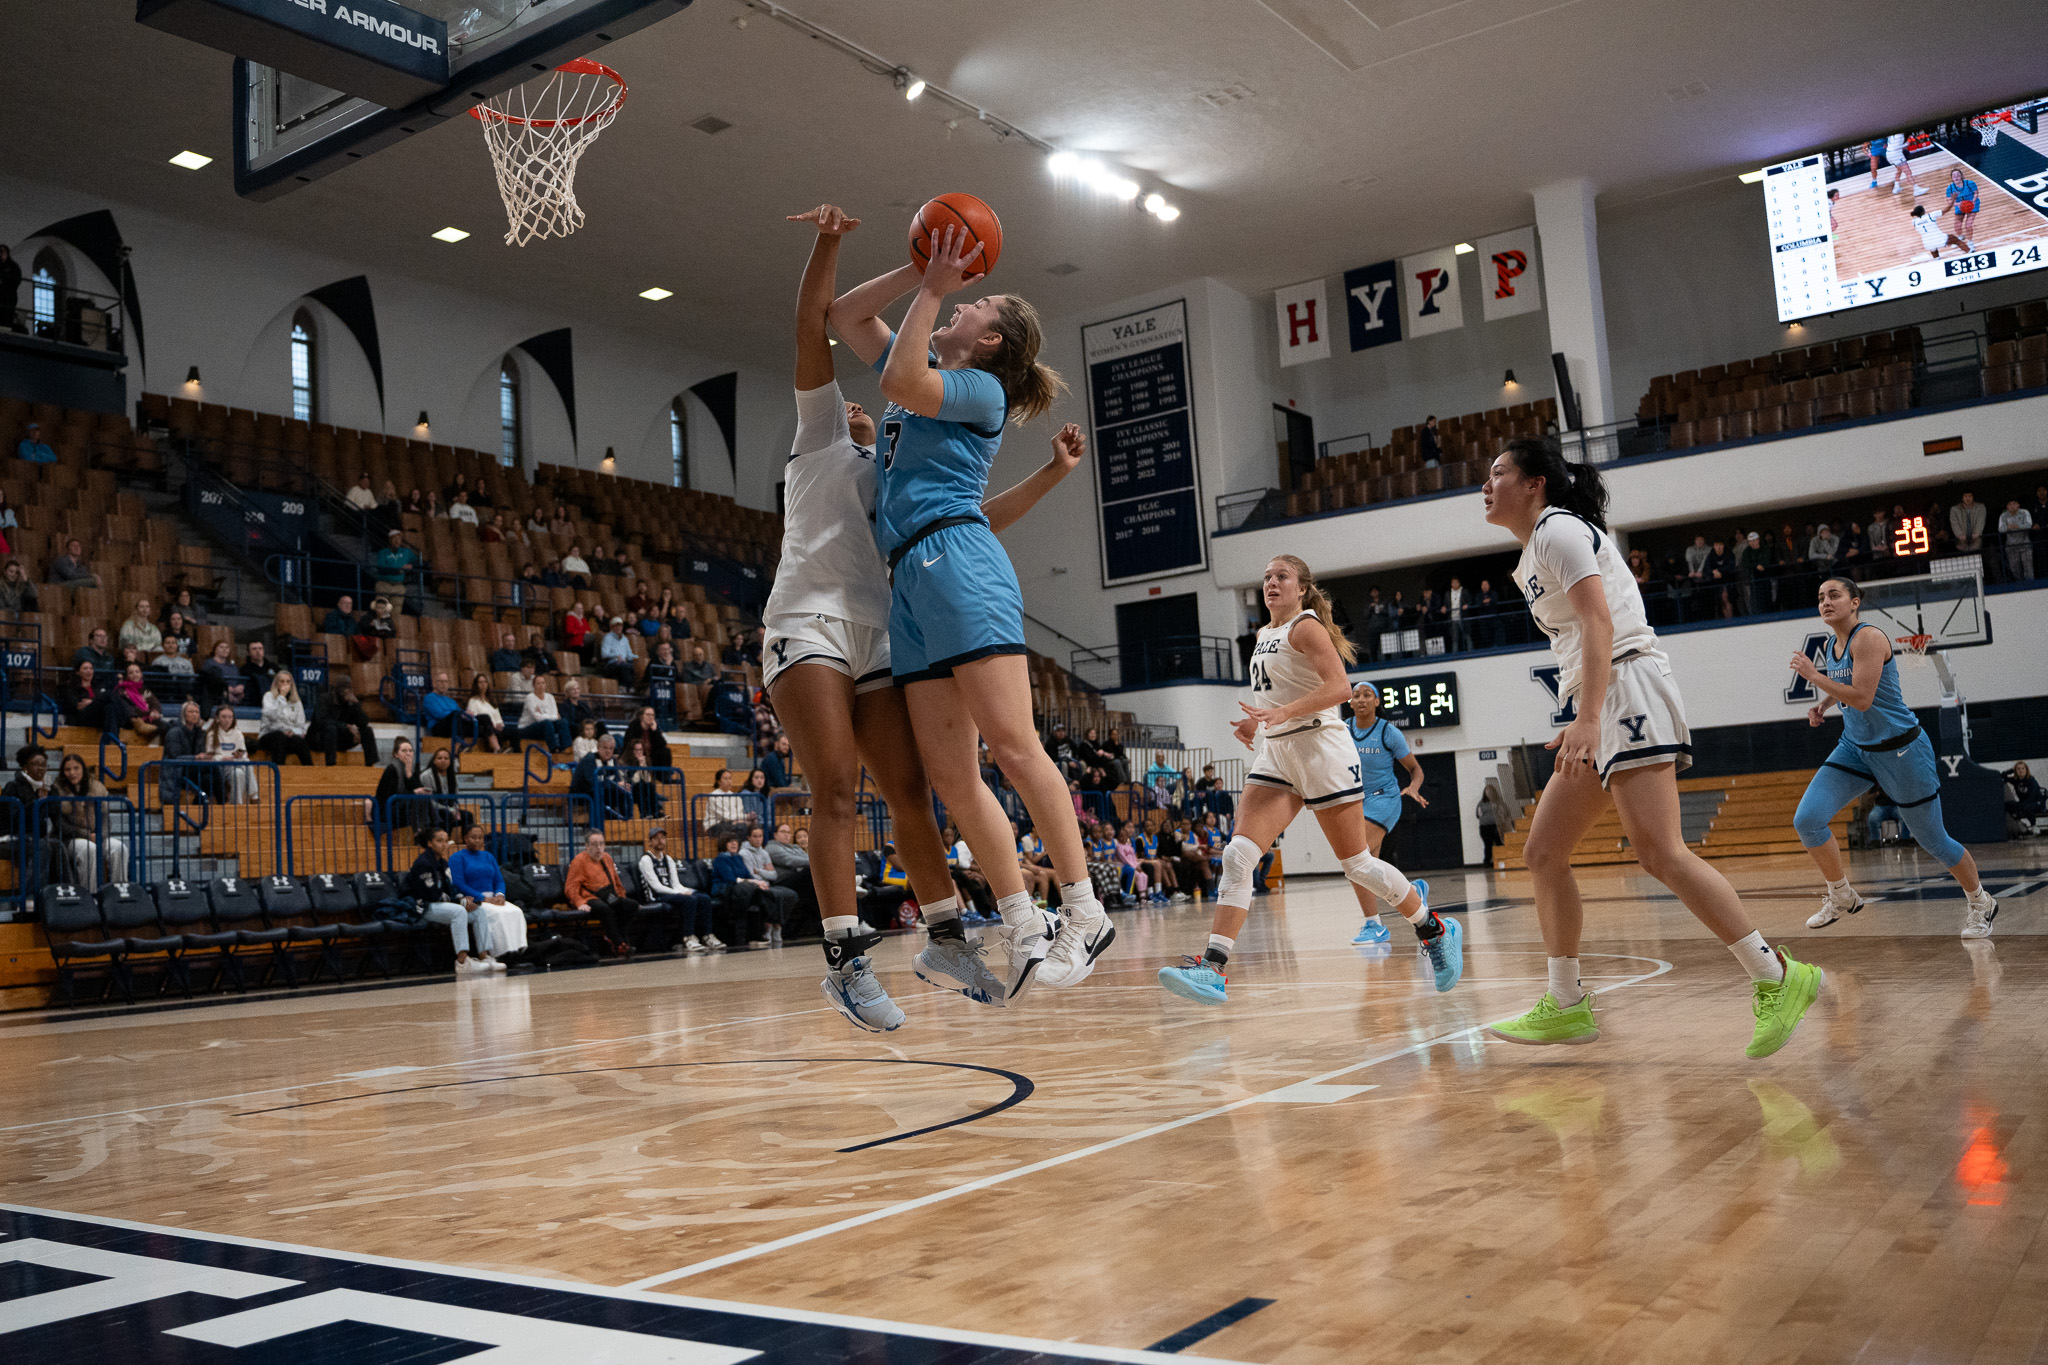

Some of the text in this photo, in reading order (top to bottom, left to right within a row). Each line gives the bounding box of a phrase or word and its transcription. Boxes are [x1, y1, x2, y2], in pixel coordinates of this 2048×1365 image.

[1781, 161, 1804, 172] YALE
[1780, 236, 1823, 252] COLUMBIA
[1491, 249, 1528, 300] P
[1865, 245, 2042, 298] Y 9 3:13 24
[1415, 268, 1450, 318] P
[1350, 279, 1393, 331] Y
[1112, 317, 1157, 340] YALE
[1286, 298, 1319, 347] H
[1129, 328, 1183, 347] GYMNASTICS
[1111, 362, 1165, 382] CHAMPIONS
[1112, 353, 1162, 373] IVY LEAGUE
[1116, 419, 1169, 438] IVY CLASSIC
[1116, 429, 1170, 448] CHAMPIONS
[884, 420, 903, 472] 3
[282, 501, 305, 516] 209
[1123, 507, 1177, 525] CHAMPIONS
[1137, 500, 1161, 512] ECAC
[1894, 526, 1930, 557] 29
[6, 653, 32, 667] 107
[770, 637, 790, 668] Y
[301, 669, 322, 681] 107
[1252, 660, 1273, 692] 24
[1784, 631, 1831, 705] A
[1382, 684, 1422, 709] 3:13
[1429, 693, 1454, 716] 24
[1618, 713, 1648, 744] Y
[1347, 764, 1361, 784] Y
[1941, 754, 1964, 778] Y
